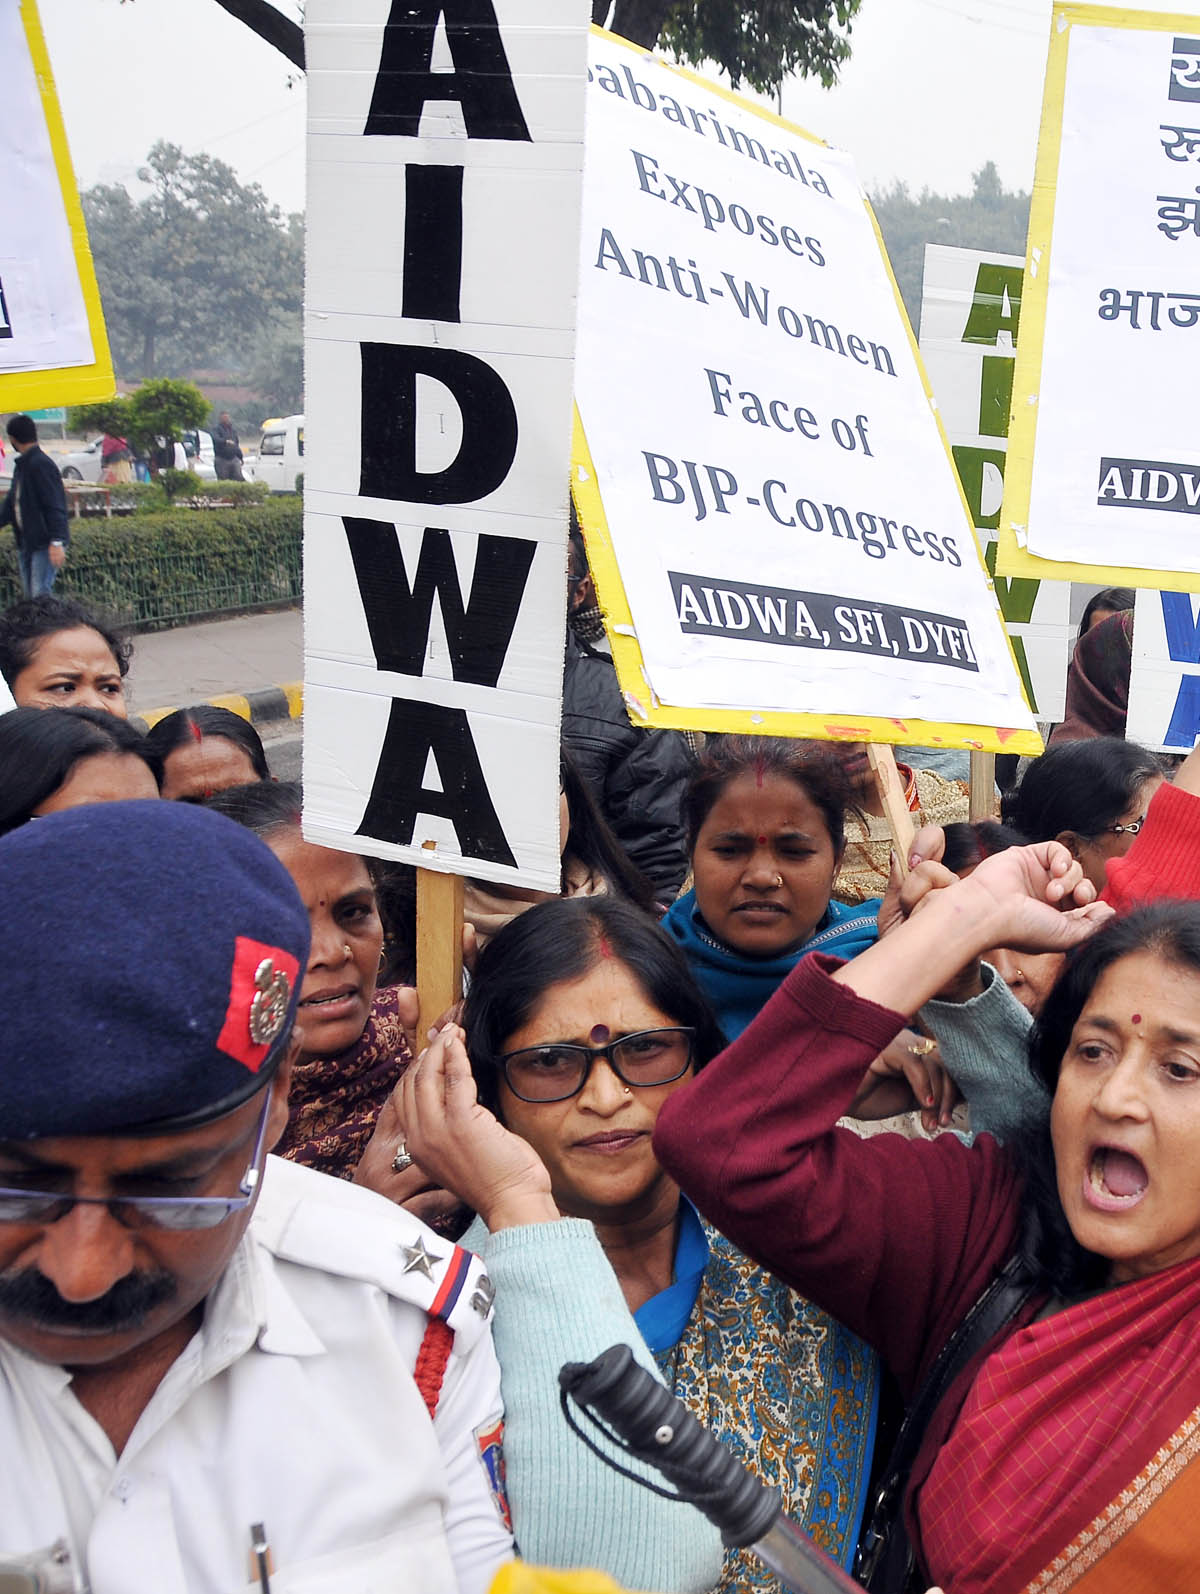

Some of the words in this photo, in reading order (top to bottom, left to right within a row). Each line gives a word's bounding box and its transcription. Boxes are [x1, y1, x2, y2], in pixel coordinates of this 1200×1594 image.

[630, 148, 826, 267] Exposes
[593, 227, 898, 378] Anti-Women
[703, 367, 821, 440] Face
[831, 414, 875, 458] of
[640, 450, 962, 568] BJP-Congress
[679, 583, 831, 647] AIDWA,
[833, 604, 900, 656] SFI,
[900, 616, 977, 664] DYFI
